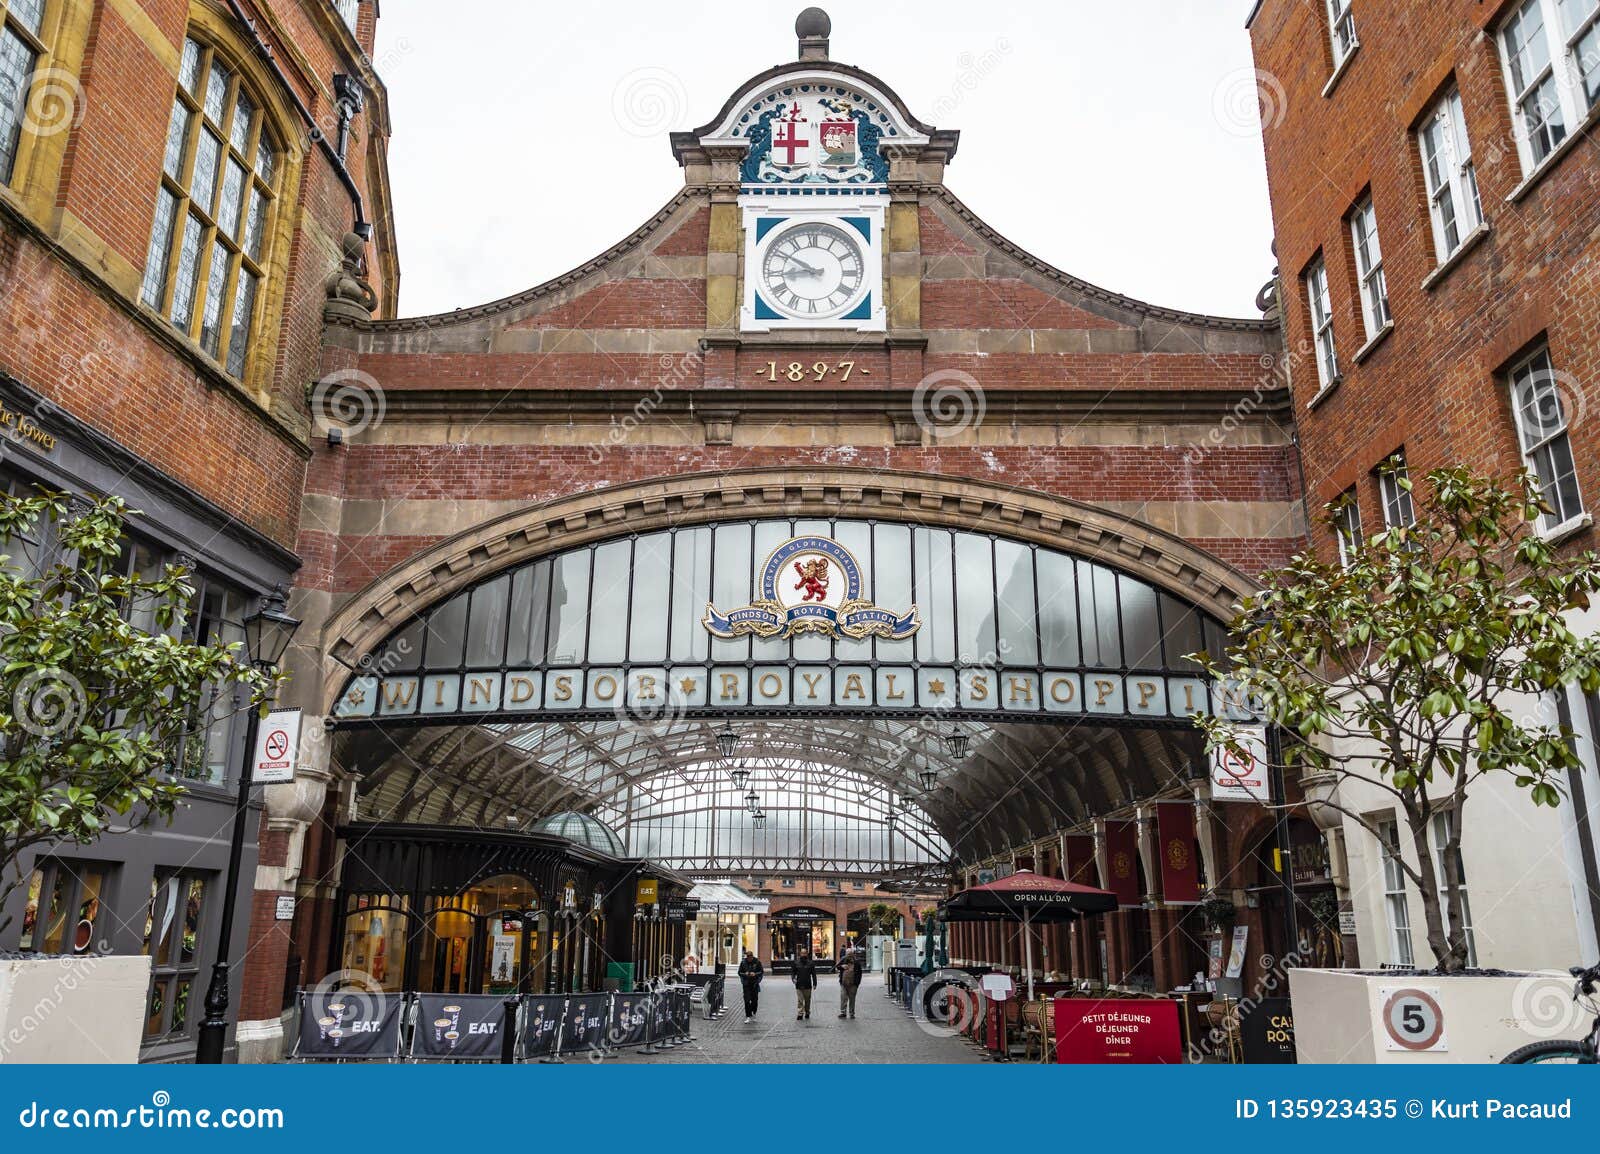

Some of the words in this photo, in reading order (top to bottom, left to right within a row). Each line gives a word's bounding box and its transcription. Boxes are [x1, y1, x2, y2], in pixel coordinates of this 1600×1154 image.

[0, 401, 14, 427] he
[16, 412, 57, 449] Tower
[789, 540, 829, 551] GLORIA
[729, 610, 777, 623] WINDSOR
[793, 607, 829, 617] ROYAL
[849, 612, 896, 625] STATION
[381, 673, 656, 708] WINDSOR
[720, 672, 904, 699] ROYAL
[970, 675, 1245, 711] SHOPPIN
[1014, 894, 1037, 902] OPEN
[1082, 1013, 1106, 1025] PETIT
[1108, 1011, 1151, 1024] DÉJEUNER
[1402, 1004, 1426, 1034] 5
[352, 1021, 381, 1033] EAT.
[468, 1022, 498, 1034] EAT.
[1096, 1023, 1139, 1033] DÉJEUNER
[1105, 1034, 1131, 1045] DÎNER
